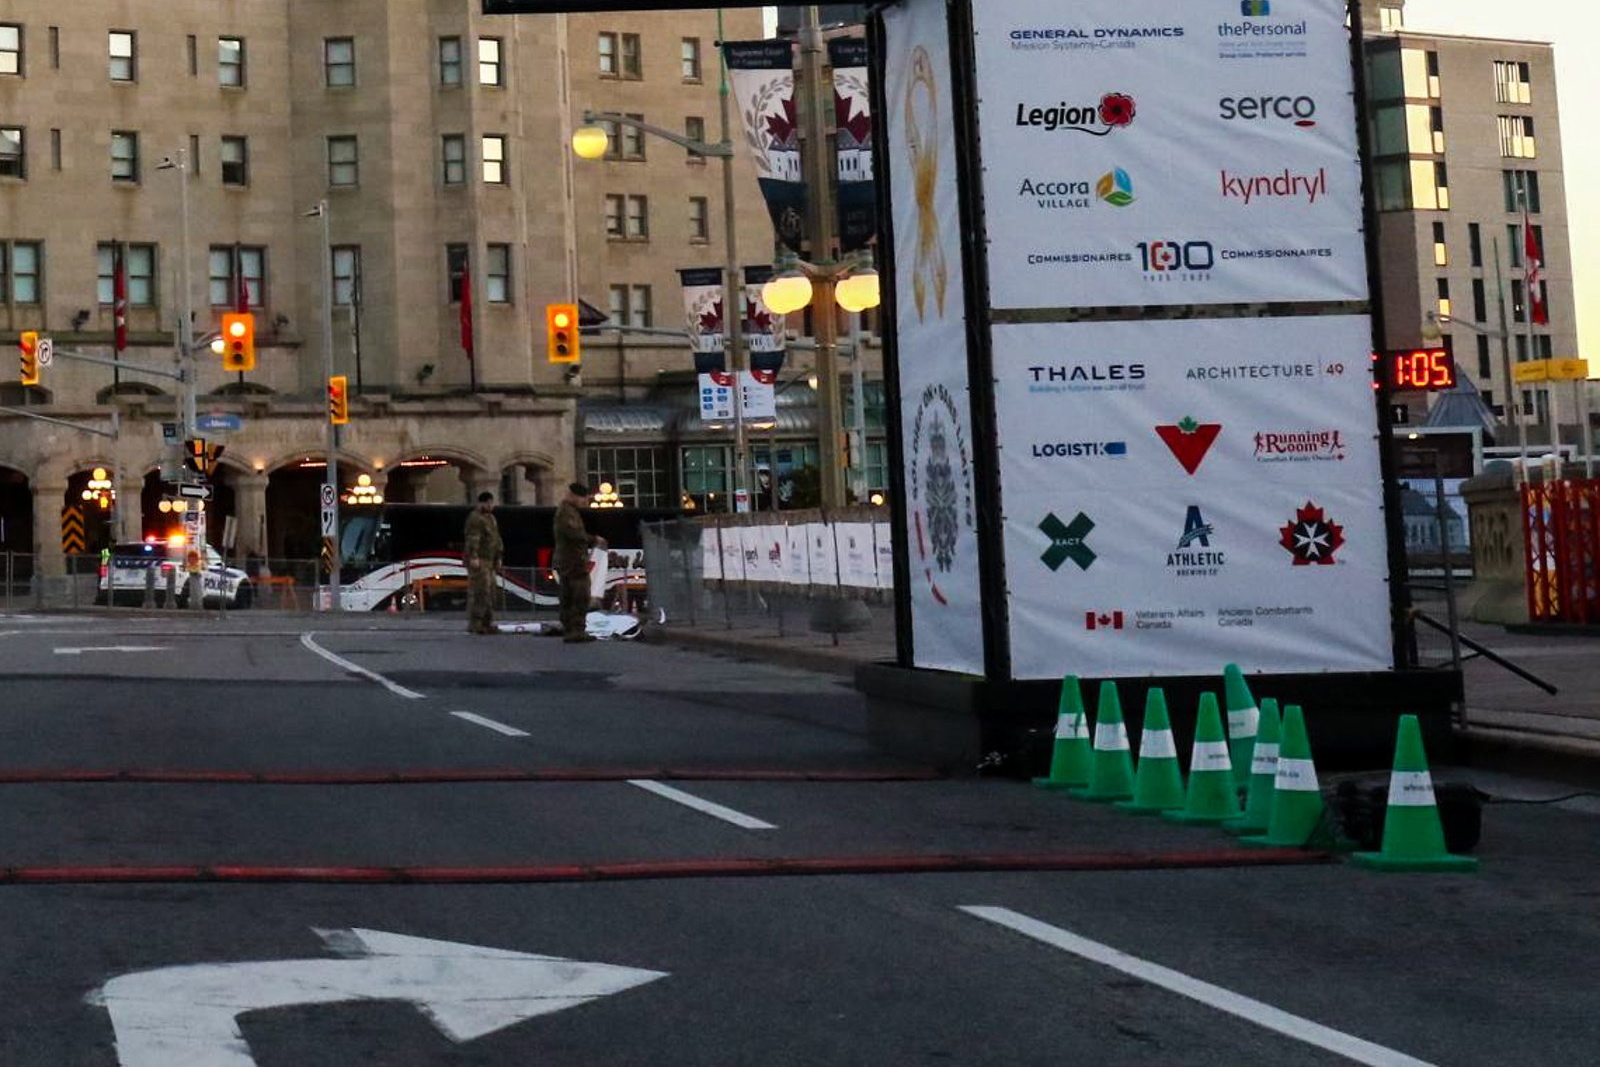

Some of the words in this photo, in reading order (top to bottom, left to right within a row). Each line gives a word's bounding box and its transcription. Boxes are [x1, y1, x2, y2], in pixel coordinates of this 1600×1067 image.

[1010, 30, 1089, 39] GENERAL
[1094, 28, 1184, 38] DYNAMICS
[1016, 101, 1096, 131] Legion
[1219, 96, 1315, 120] serco
[1019, 179, 1090, 196] Accora
[1220, 168, 1326, 205] kyndryl
[1038, 199, 1090, 209] VILLAGE
[1028, 364, 1146, 382] THALES
[1186, 364, 1314, 380] ARCHITECTURE
[1326, 363, 1344, 375] 49
[1266, 431, 1329, 452] Running
[1167, 552, 1224, 566] ATHLETIC
